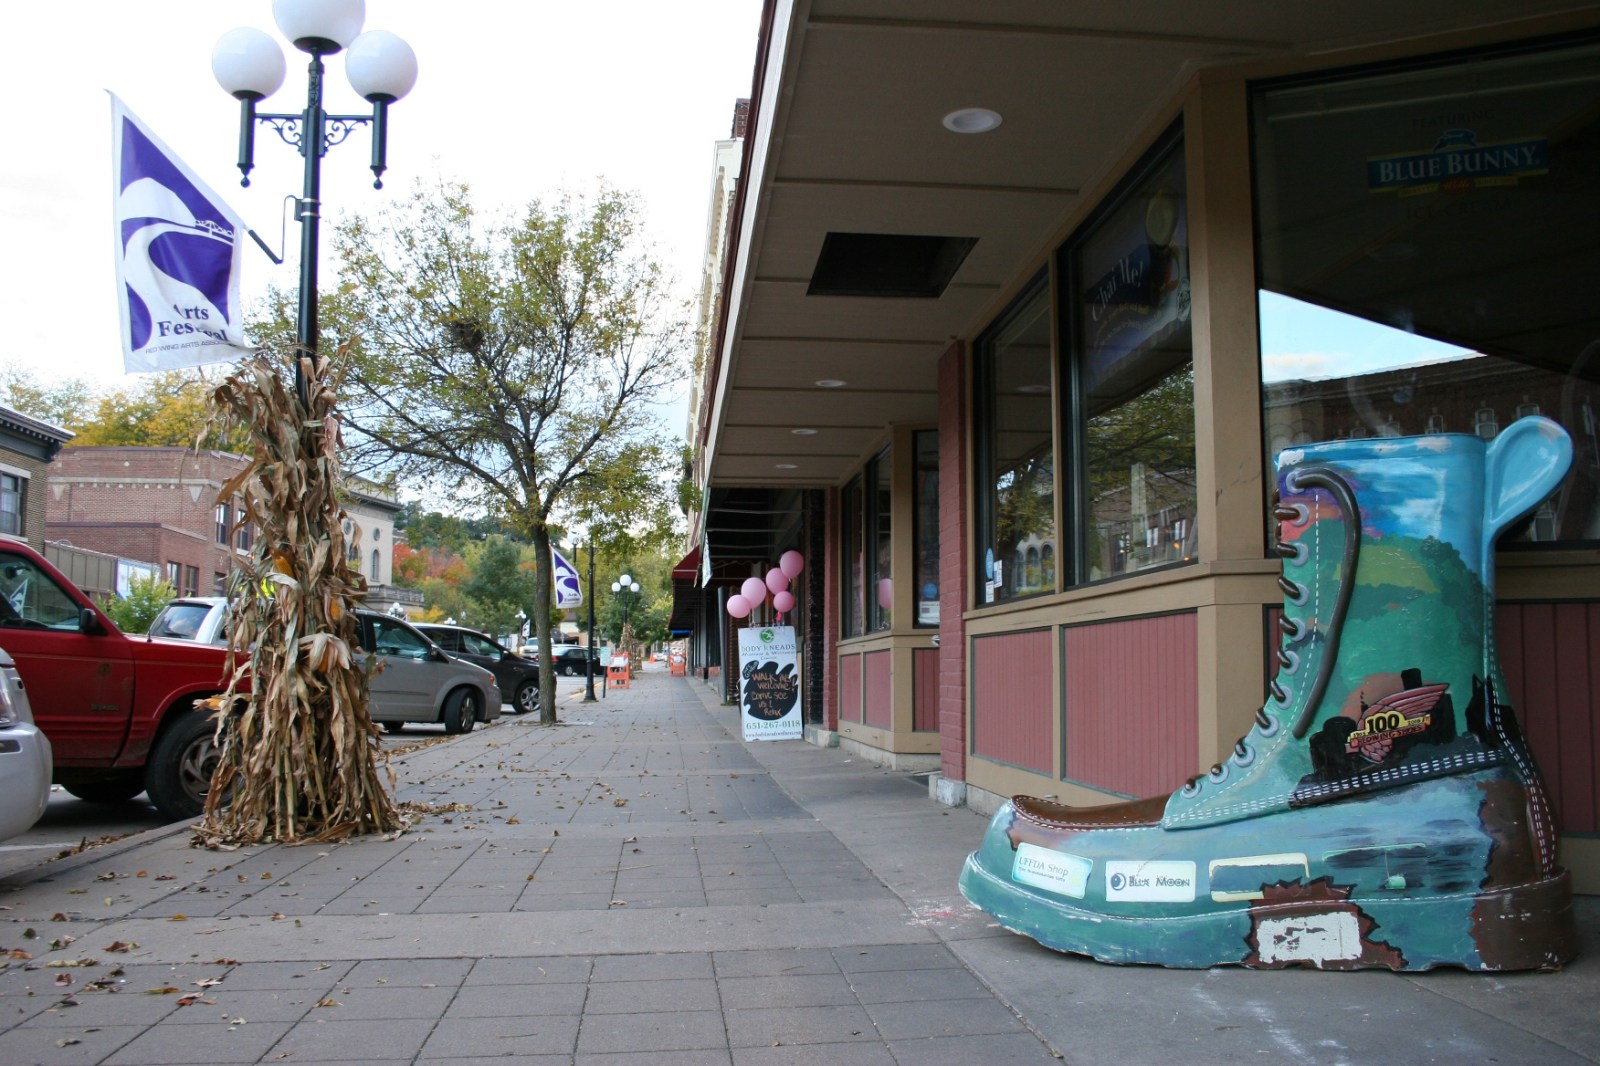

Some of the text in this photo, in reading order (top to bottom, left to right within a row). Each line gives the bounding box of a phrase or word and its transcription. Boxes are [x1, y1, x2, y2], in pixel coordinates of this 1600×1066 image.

[1378, 144, 1537, 184] BLUE BUNNY
[1091, 266, 1117, 321] Chai
[145, 346, 158, 354] RED
[158, 343, 180, 351] WING
[180, 341, 200, 349] ARTS
[752, 672, 777, 682] WALK
[746, 720, 801, 730] 651-267-0118
[1366, 713, 1400, 733] 100
[1018, 856, 1069, 877] UFFDA Shop
